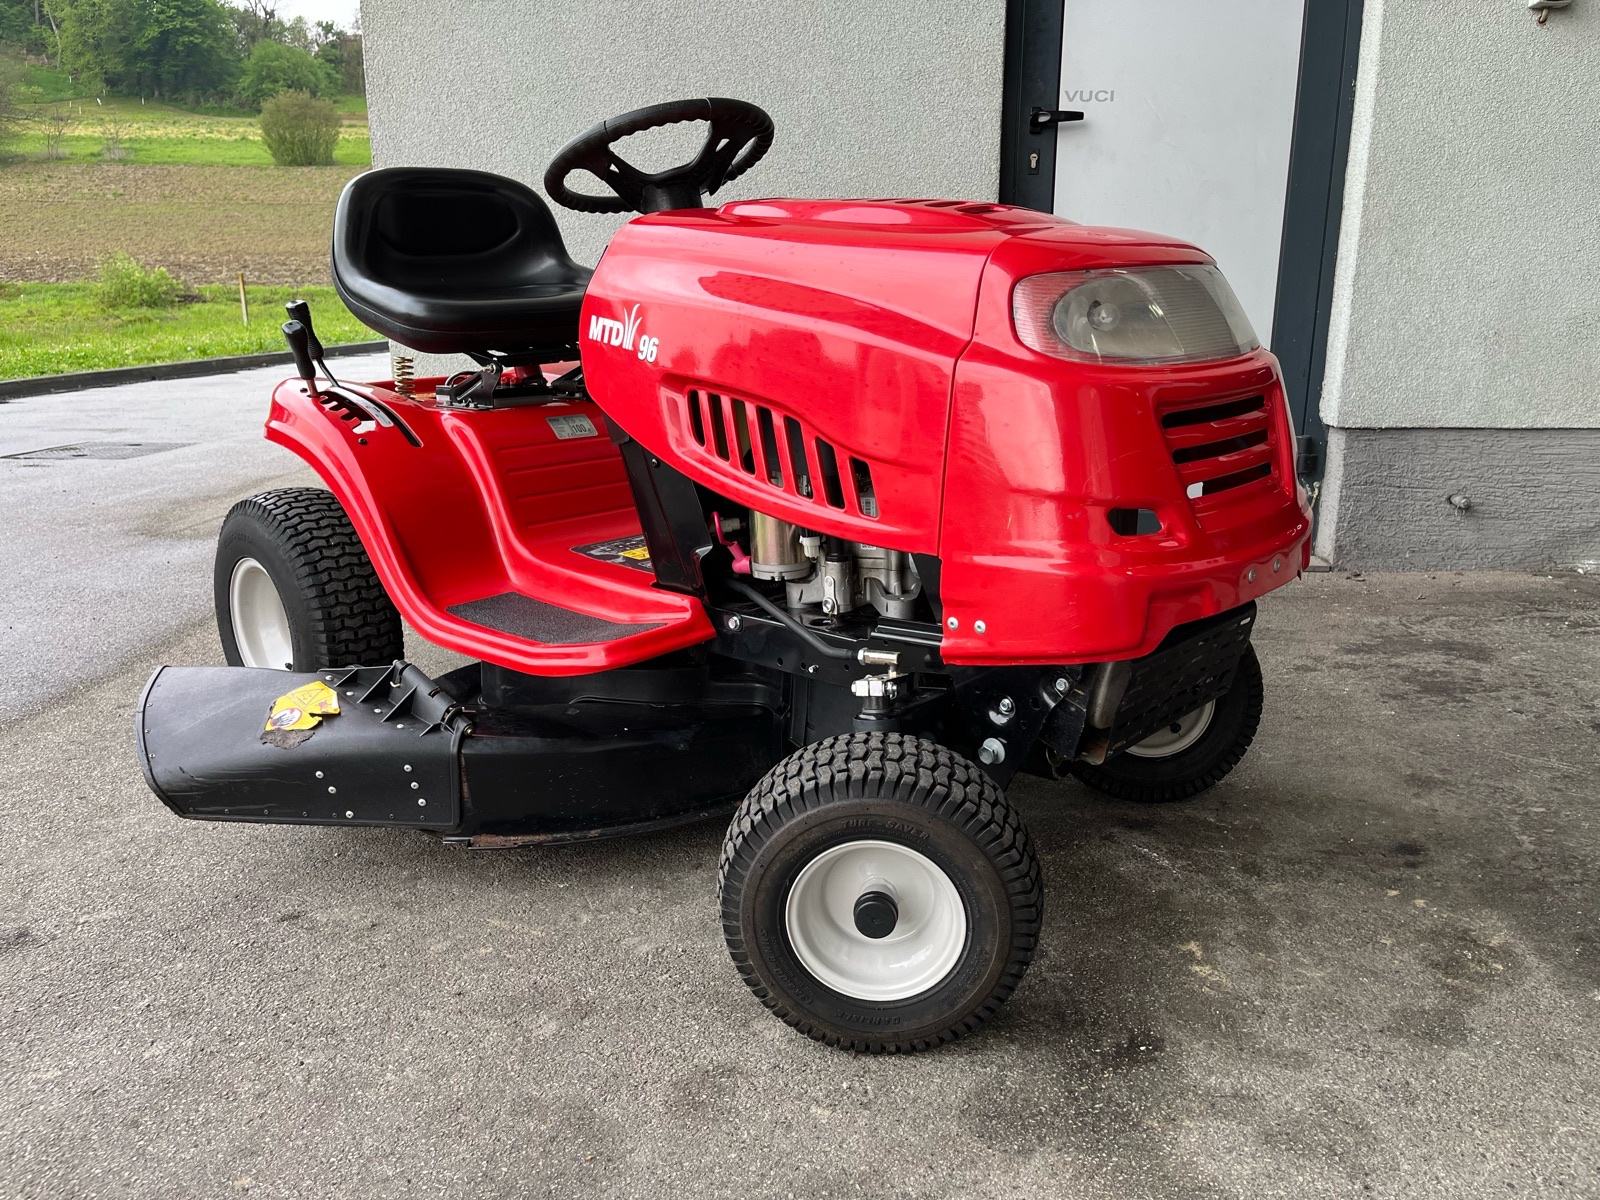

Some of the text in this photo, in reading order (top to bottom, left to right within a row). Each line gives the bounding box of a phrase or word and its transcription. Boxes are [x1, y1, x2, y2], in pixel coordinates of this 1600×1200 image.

[1064, 89, 1115, 103] VUCI
[588, 314, 659, 363] MTD 96
